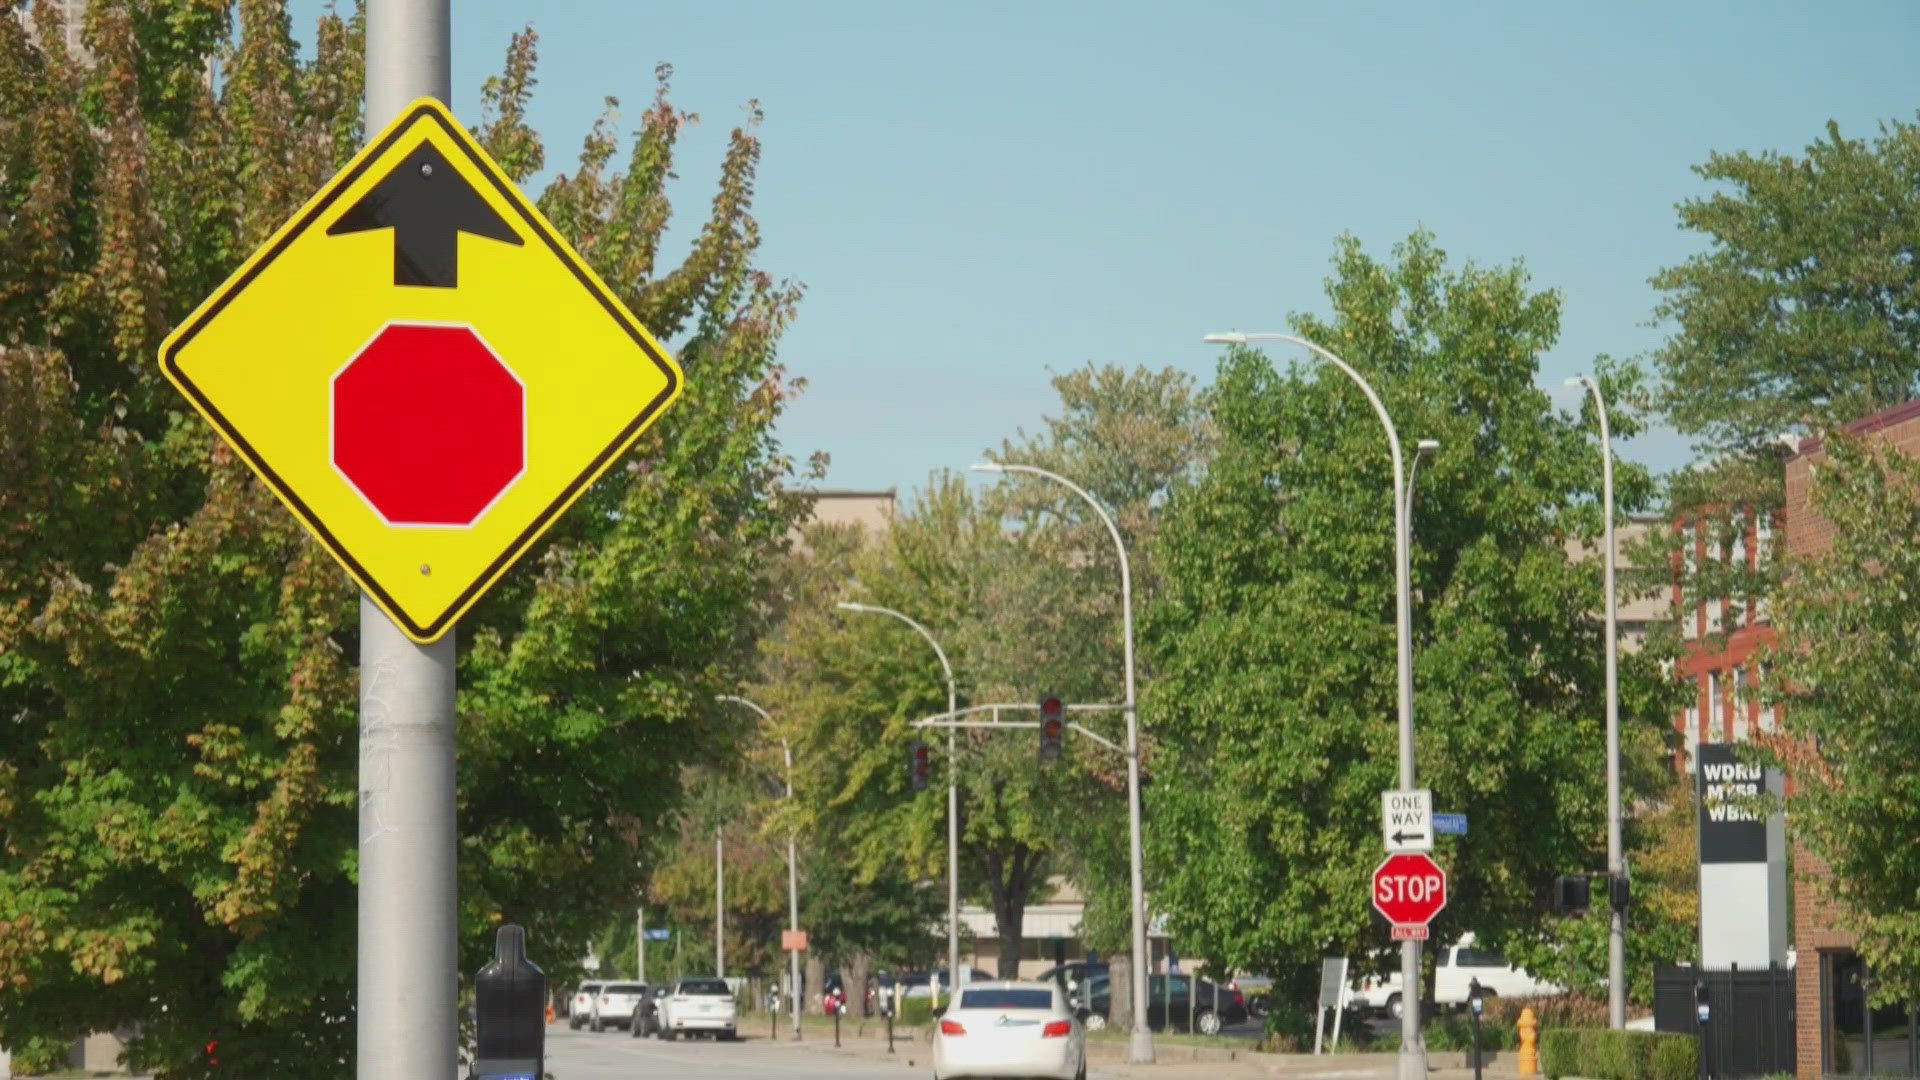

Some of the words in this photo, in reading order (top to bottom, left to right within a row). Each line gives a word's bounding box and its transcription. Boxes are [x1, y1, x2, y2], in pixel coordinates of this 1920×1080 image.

[1703, 763, 1761, 781] WDRB
[1391, 796, 1422, 810] ONE
[1392, 812, 1423, 825] WAY
[1378, 876, 1441, 903] STOP
[1394, 927, 1408, 937] ALL
[1409, 927, 1425, 937] WAY
